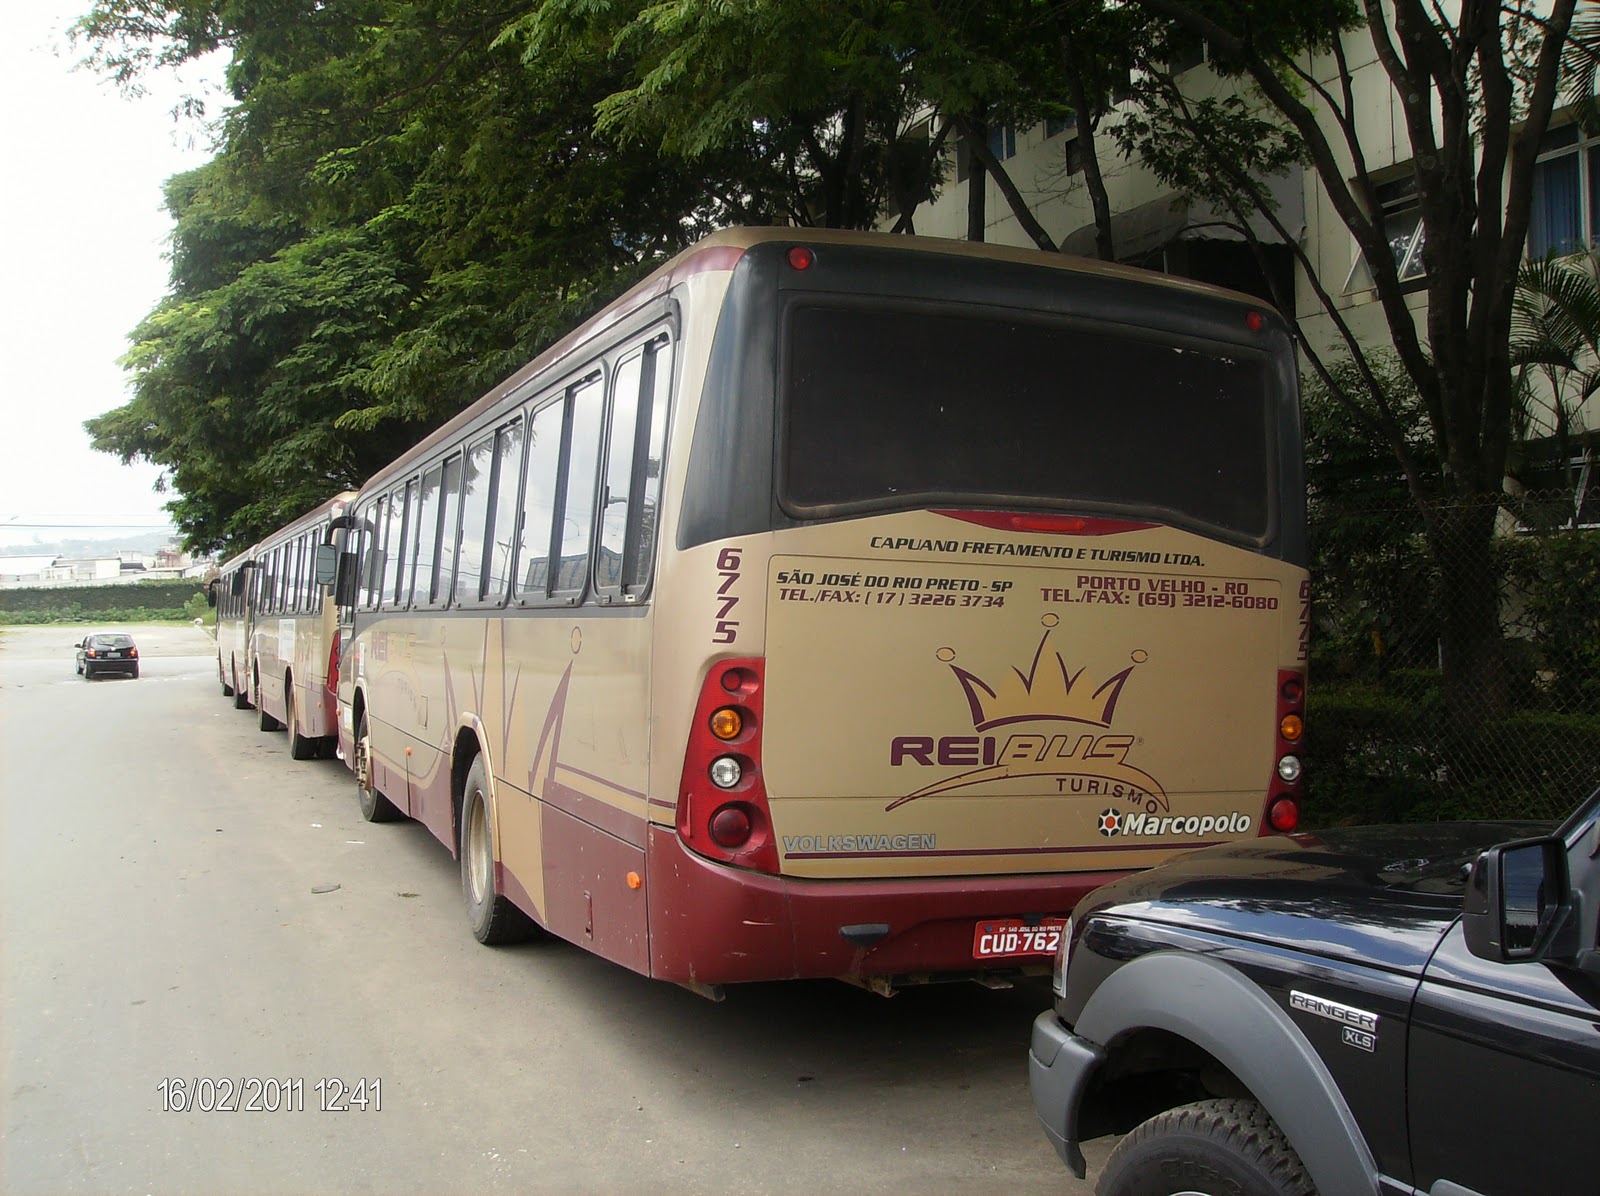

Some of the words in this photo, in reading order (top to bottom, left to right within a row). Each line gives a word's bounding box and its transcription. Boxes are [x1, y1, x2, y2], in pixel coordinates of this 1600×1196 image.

[870, 536, 958, 553] CAPUANO
[961, 541, 1073, 559] FRETAMENTO
[1076, 548, 1087, 560] E
[1090, 549, 1161, 564] TURISMO
[1163, 553, 1205, 567] LTDA.
[776, 569, 815, 585] SÃO
[816, 571, 862, 587] JOSÉ
[864, 575, 889, 588] DO
[892, 577, 923, 589] RIO
[925, 578, 980, 591] PRETO
[990, 580, 1013, 593] SP
[1077, 575, 1140, 591] PORTO
[1147, 579, 1205, 594] VELHO
[1224, 582, 1248, 596] RO
[780, 588, 861, 604] TEL./FAX:
[908, 593, 957, 607] 3226
[959, 595, 1005, 608] 3734
[1040, 588, 1130, 605] TEL./FAX:
[1138, 592, 1176, 608] (69)
[1182, 594, 1279, 610] 3212-6080
[1056, 778, 1158, 814] TURISMO
[1121, 811, 1251, 837] Marcopolo
[782, 833, 936, 851] VOLKSWAGEN
[1292, 994, 1374, 1029] RANGER
[1345, 1030, 1371, 1048] XLS
